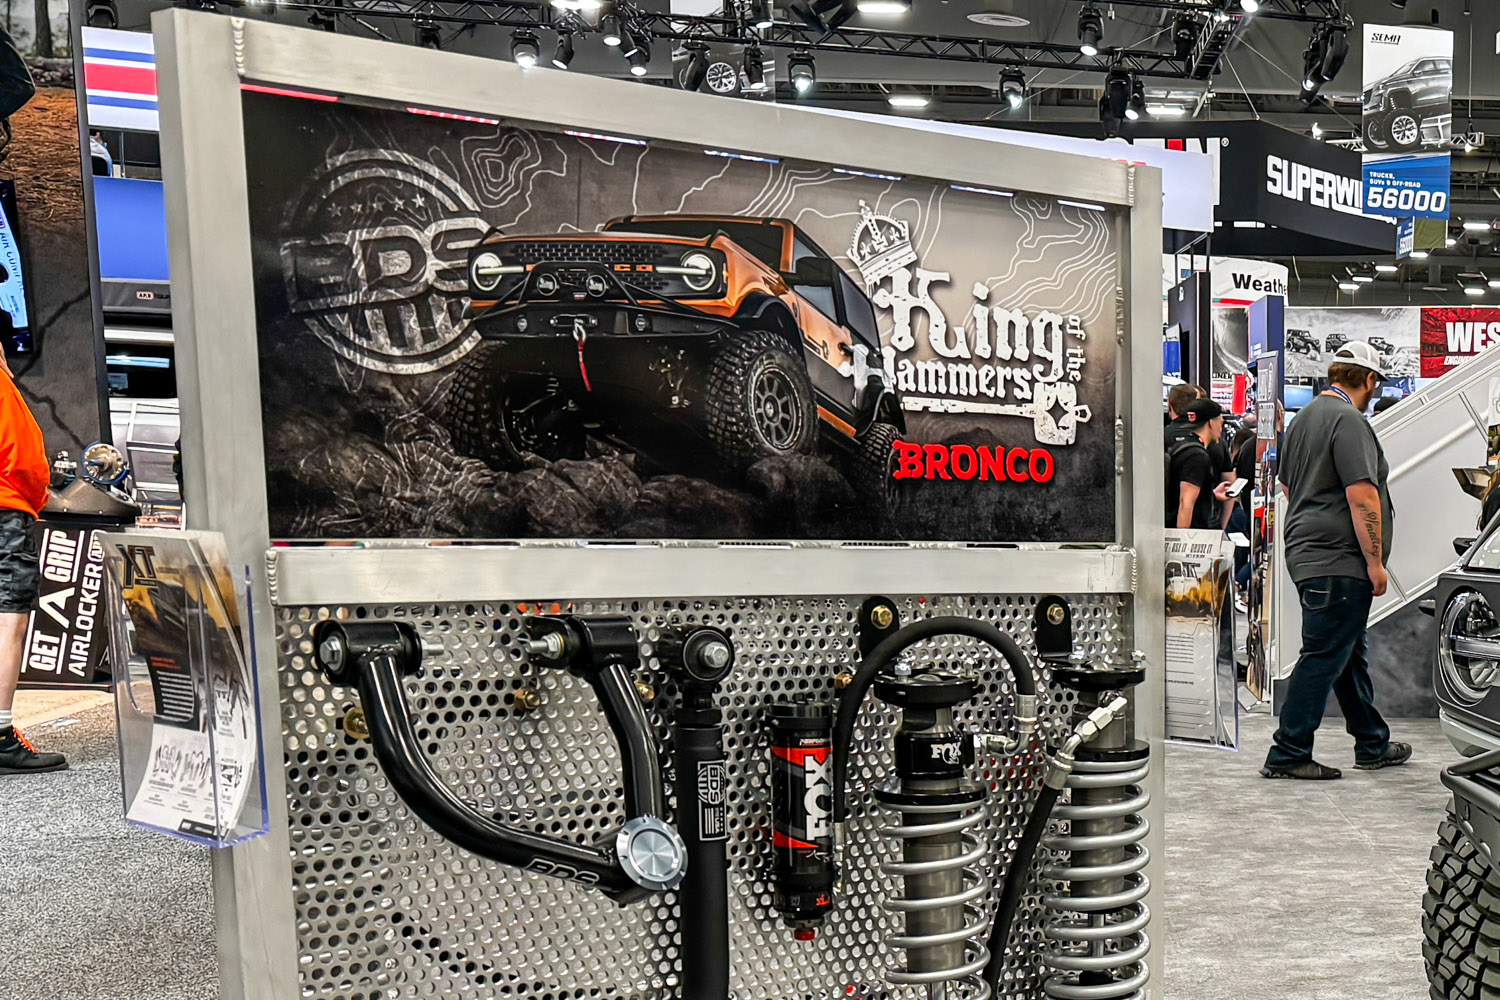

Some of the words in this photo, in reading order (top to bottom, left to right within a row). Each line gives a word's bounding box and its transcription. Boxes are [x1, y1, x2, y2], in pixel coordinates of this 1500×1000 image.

[1267, 155, 1362, 209] SUPERWI
[1367, 187, 1447, 213] 56000
[873, 267, 1064, 382] King
[1066, 315, 1086, 341] of
[1066, 346, 1086, 382] the
[893, 440, 1054, 483] BRONCO
[43, 530, 77, 583] GRIP
[39, 587, 76, 629] A
[68, 562, 104, 677] AIRLOCKER
[29, 630, 61, 671] GET
[931, 742, 961, 764] FOX
[707, 765, 721, 805] BDS
[524, 858, 600, 885] BDS
